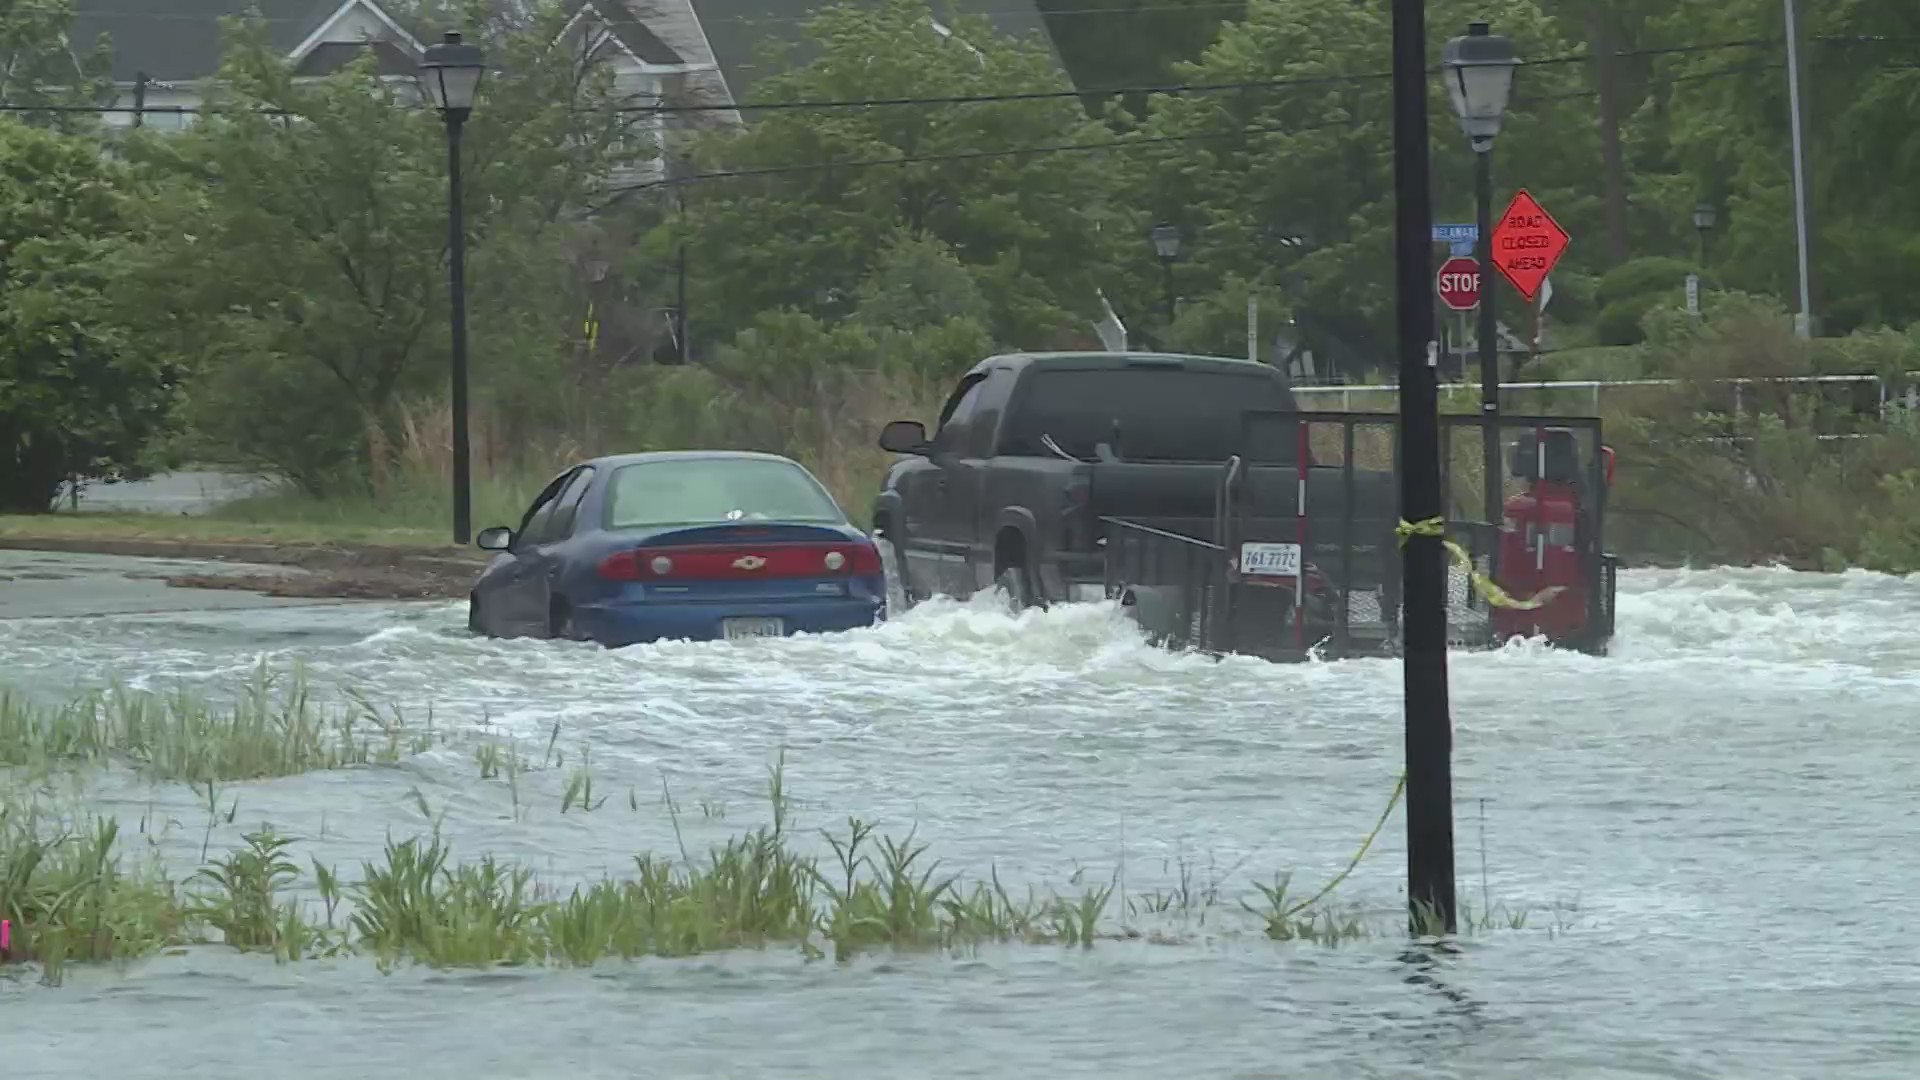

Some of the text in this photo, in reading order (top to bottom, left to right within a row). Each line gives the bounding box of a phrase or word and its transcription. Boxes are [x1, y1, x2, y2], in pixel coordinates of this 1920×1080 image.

[1508, 215, 1542, 228] ROAD
[1502, 235, 1548, 250] CLOSED
[1508, 256, 1545, 270] AHEAD
